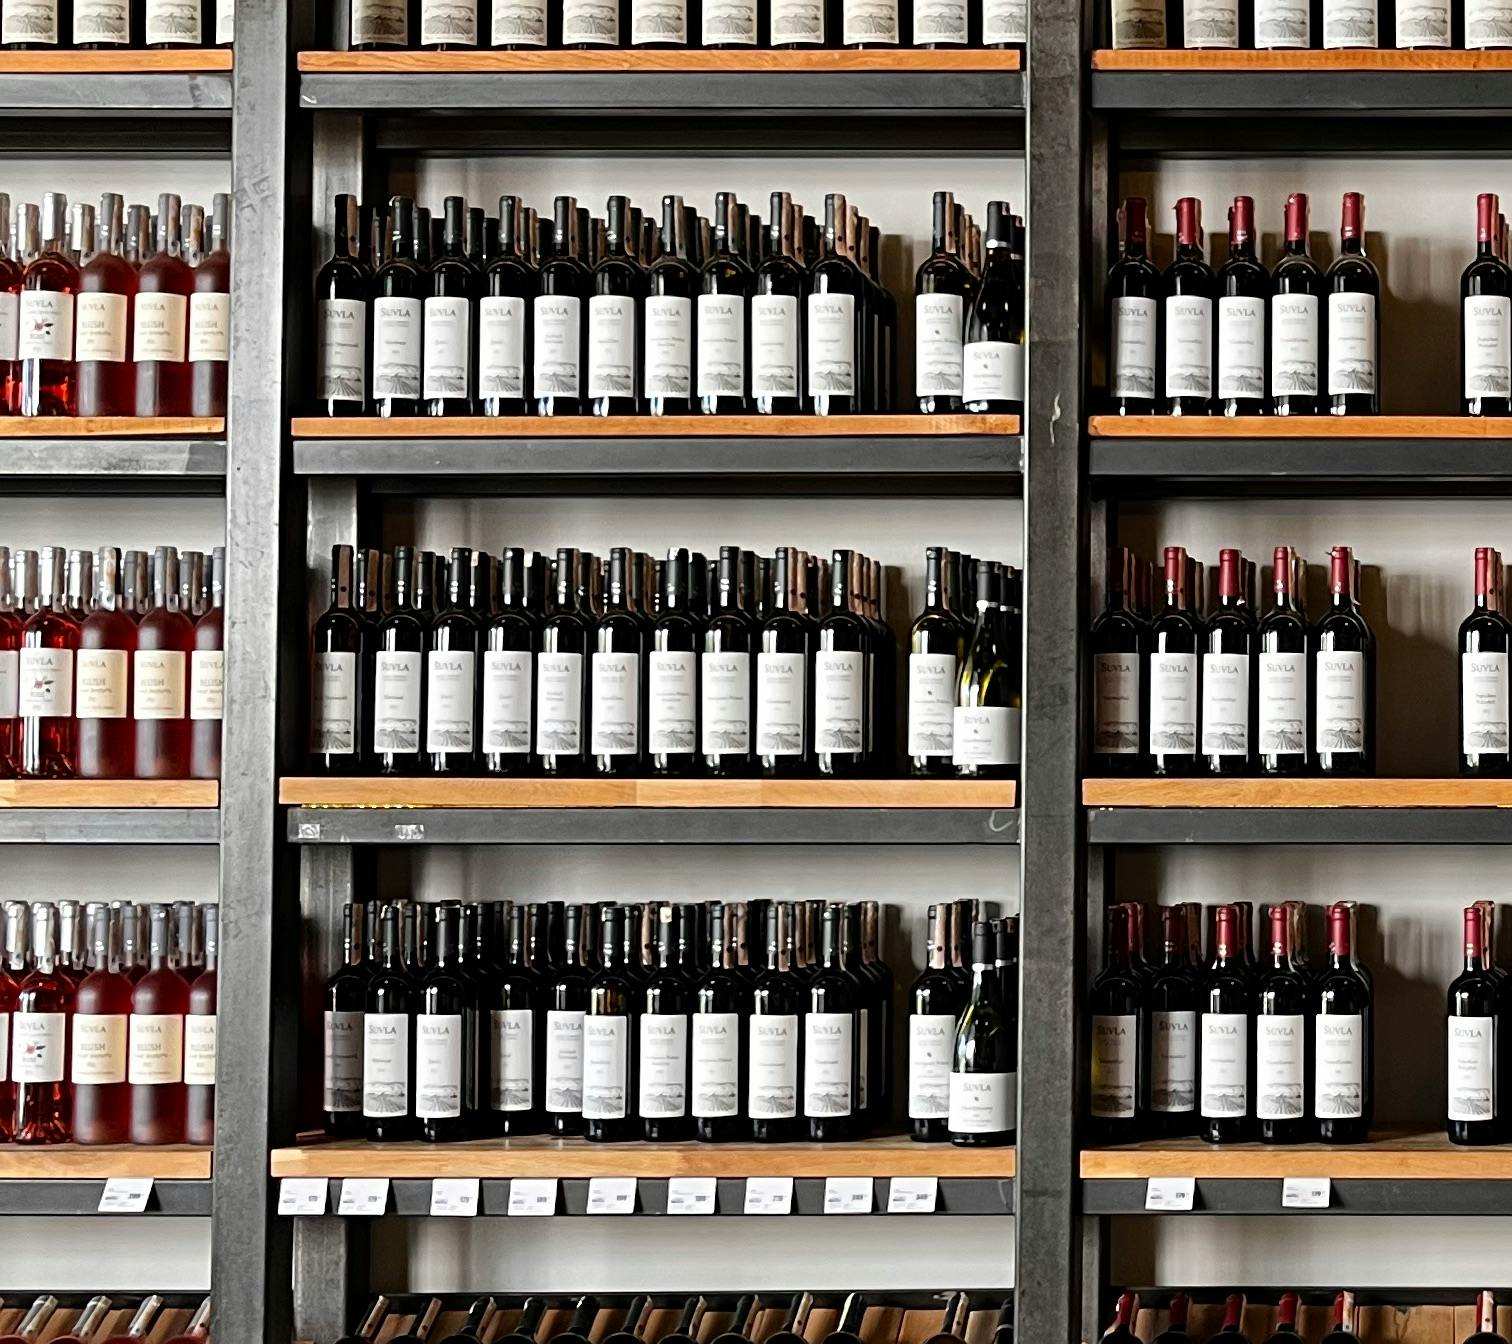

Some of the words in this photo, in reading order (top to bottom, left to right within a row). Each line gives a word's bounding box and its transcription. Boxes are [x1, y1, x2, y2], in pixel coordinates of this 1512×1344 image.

[380, 307, 412, 319] SUVLA
[924, 304, 955, 315] SUVLA
[1116, 306, 1149, 318] SUVLA
[1226, 307, 1257, 318] SUVLA
[1279, 304, 1310, 316] SUVLA
[1472, 305, 1504, 319] SUVLA
[491, 661, 523, 672] SUVLA
[916, 665, 947, 676] SUVLA
[1210, 663, 1240, 675] SUVLA
[1266, 663, 1296, 673] SUVLA
[1324, 661, 1355, 672] SUVLA
[812, 1025, 843, 1036] SUVLA
[916, 1026, 946, 1038] SUVLA
[1323, 1024, 1353, 1037] SUVLA
